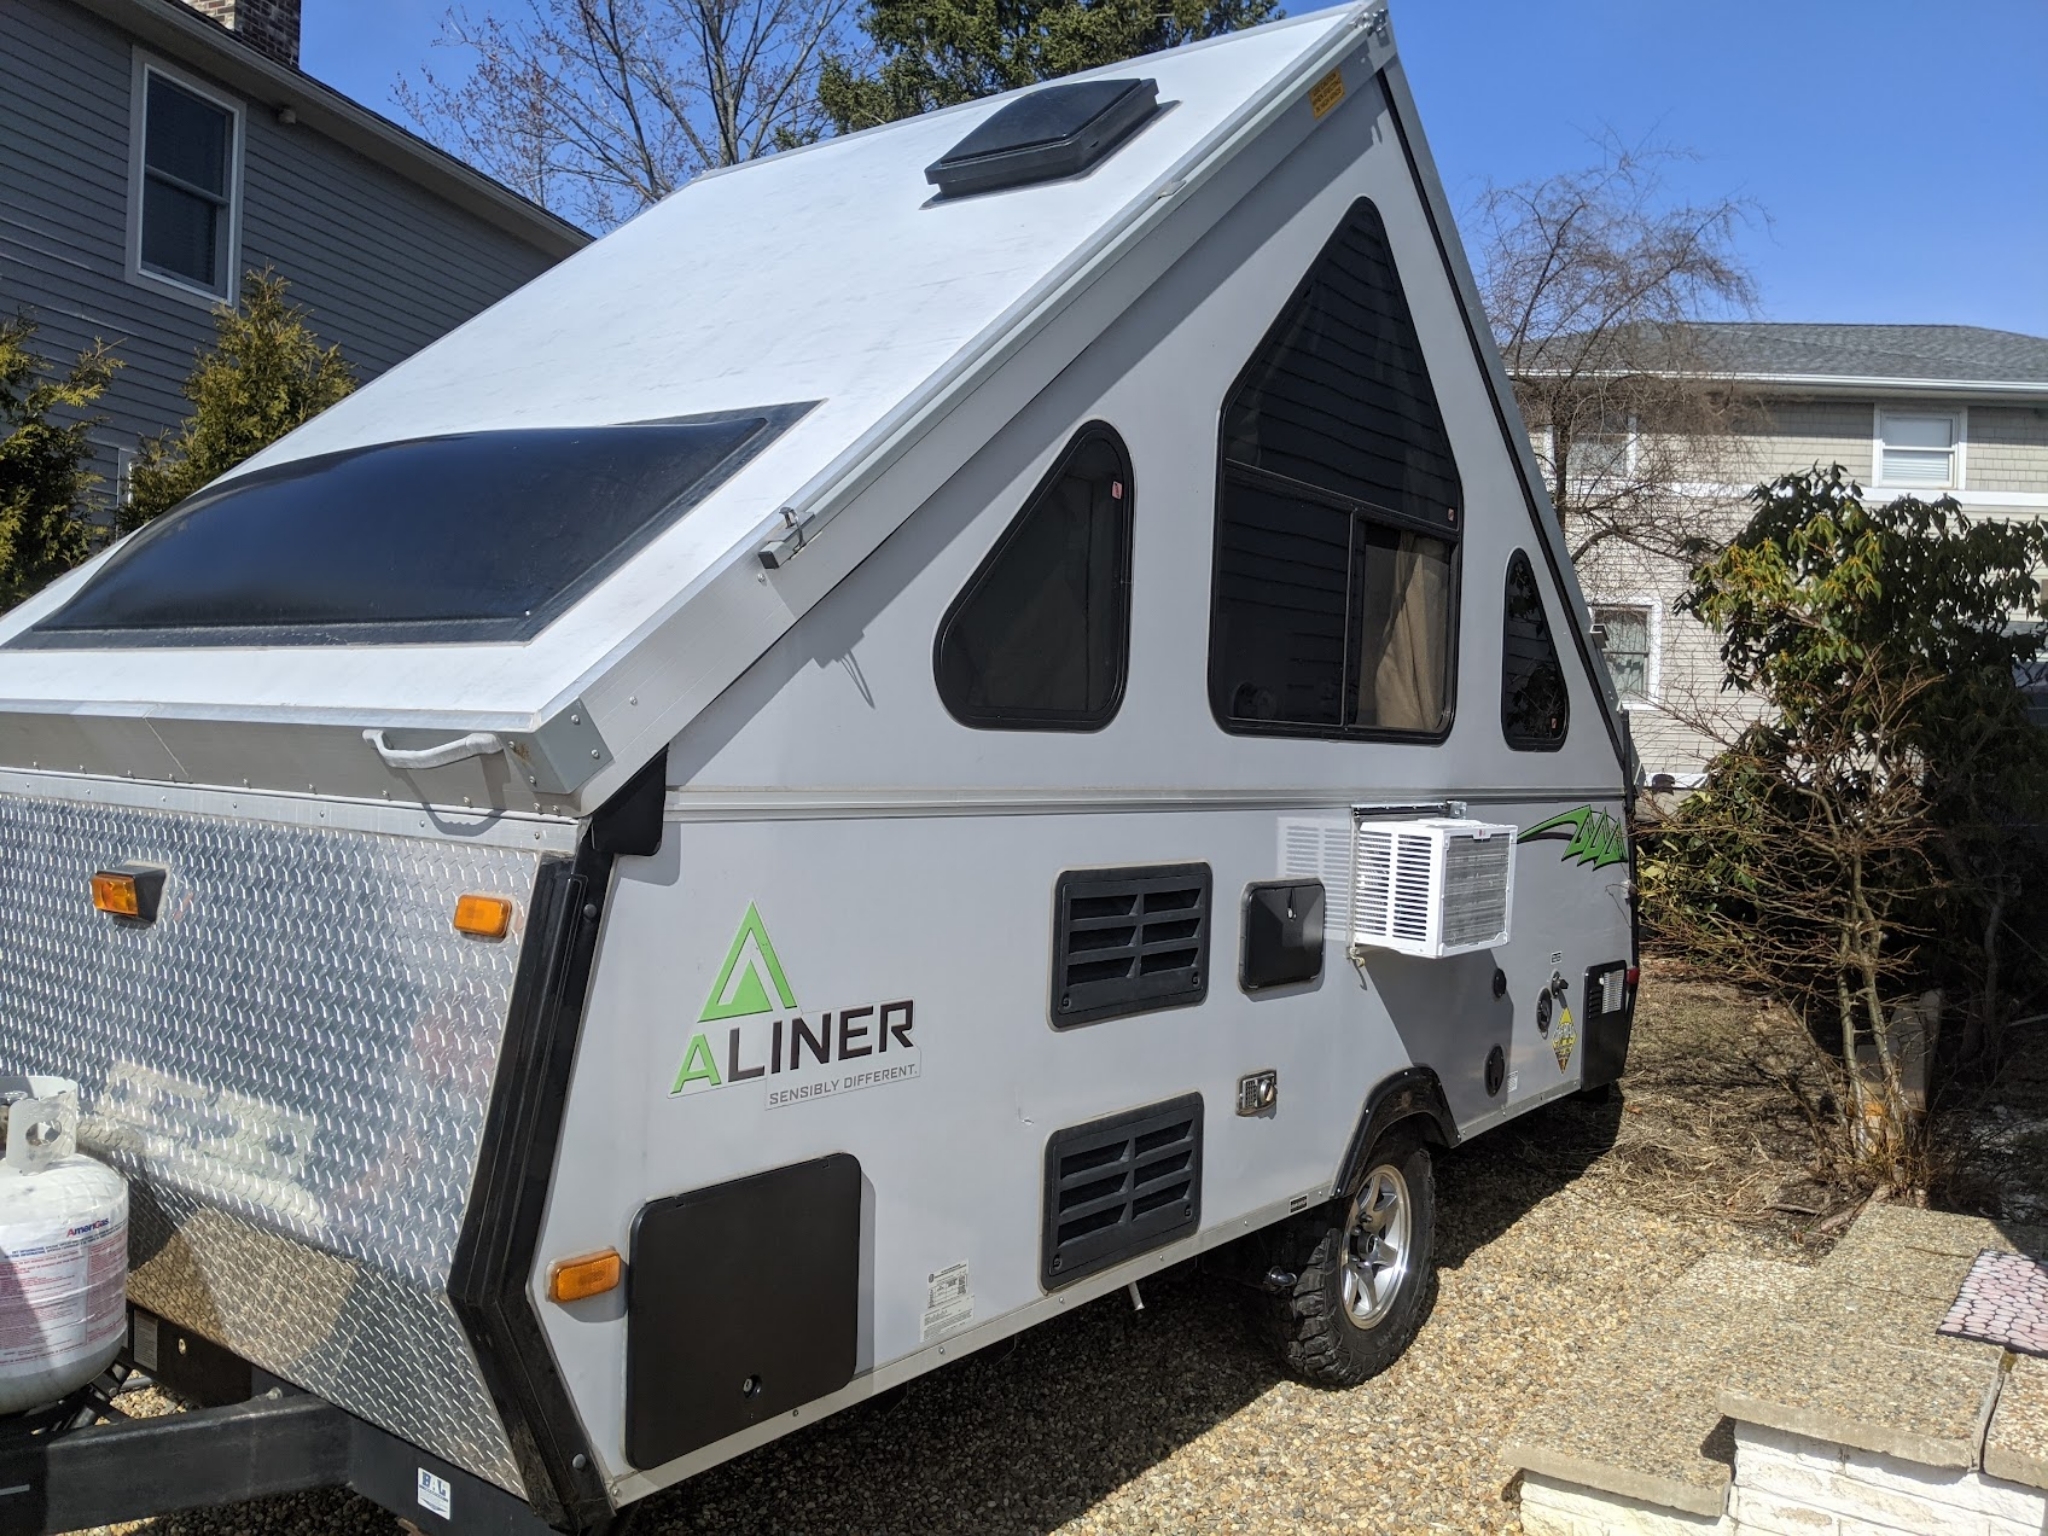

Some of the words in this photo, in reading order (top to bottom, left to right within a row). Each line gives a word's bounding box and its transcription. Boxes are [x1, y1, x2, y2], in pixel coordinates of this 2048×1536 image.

[670, 999, 914, 1094] ALINER
[769, 1080, 840, 1105] SENSIBLY
[843, 1064, 918, 1089] DIFFERENT.
[67, 1218, 109, 1237] AmeriGas
